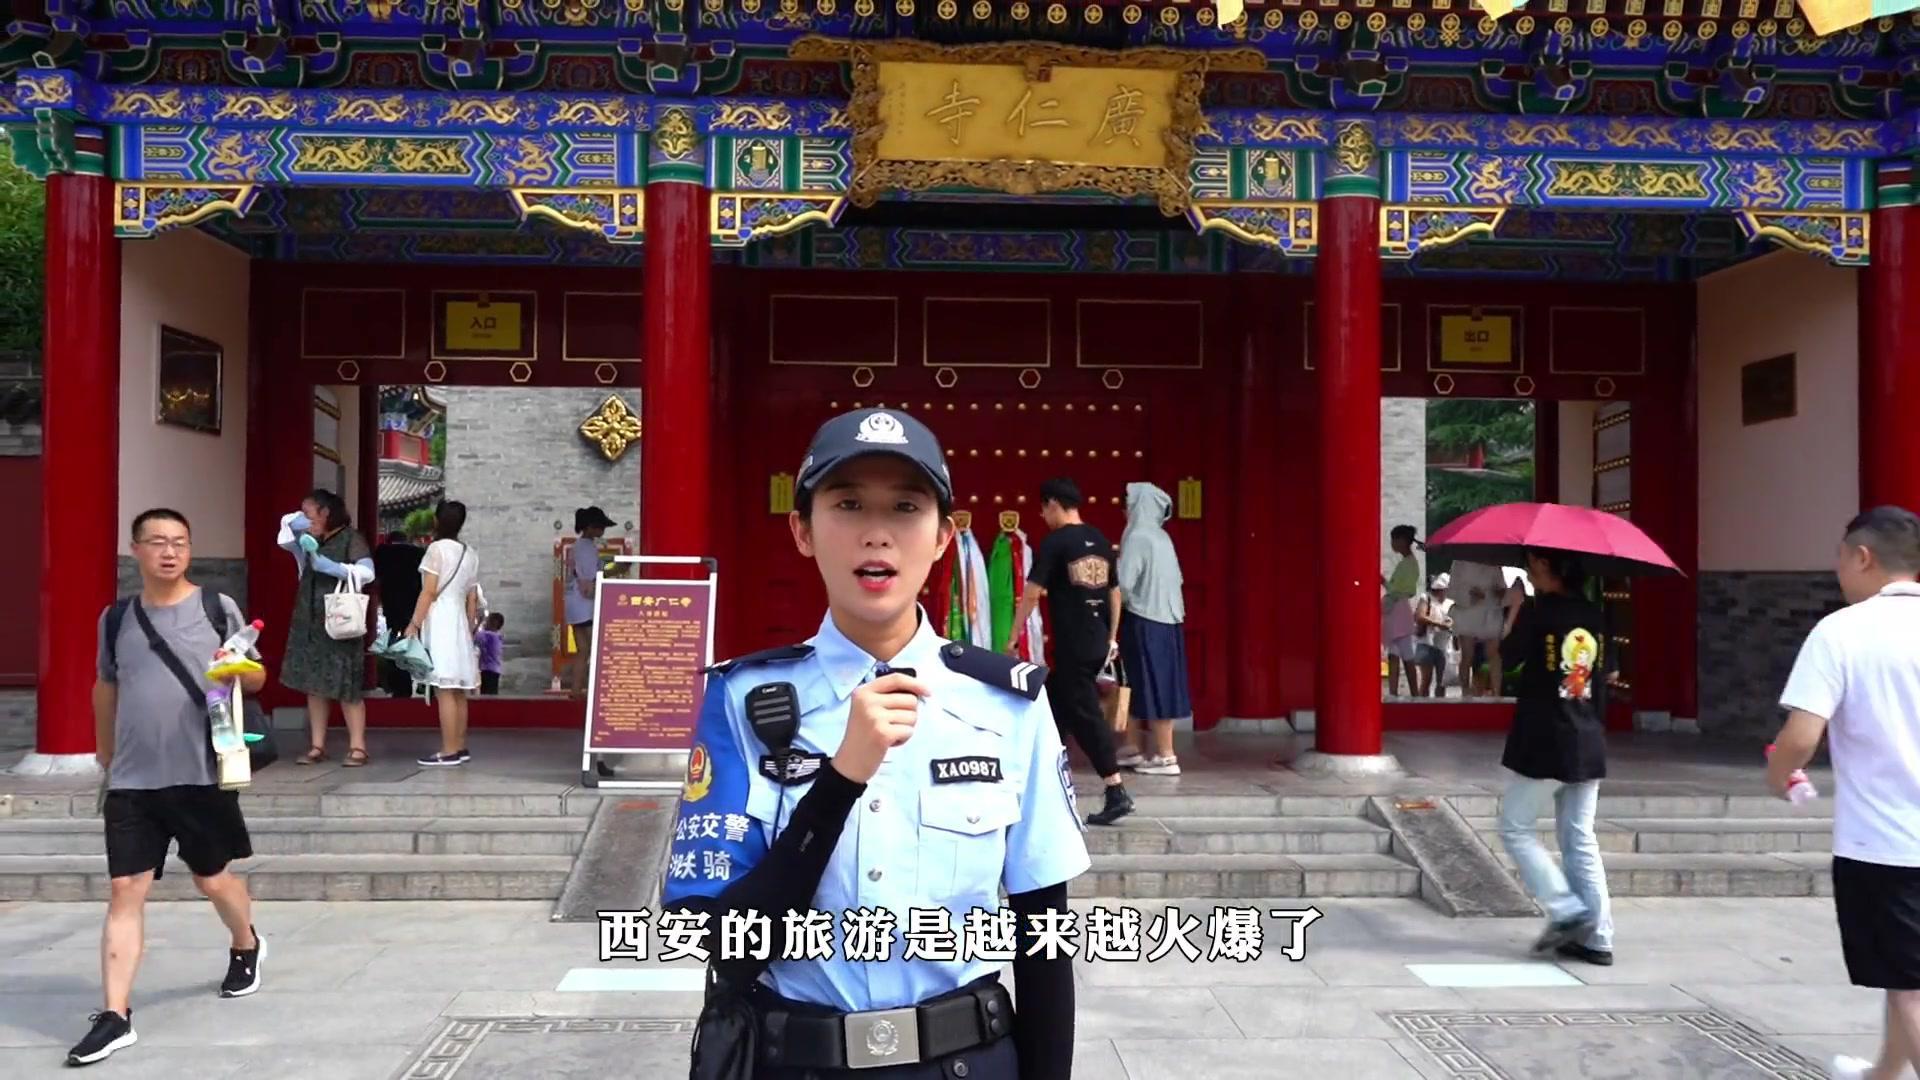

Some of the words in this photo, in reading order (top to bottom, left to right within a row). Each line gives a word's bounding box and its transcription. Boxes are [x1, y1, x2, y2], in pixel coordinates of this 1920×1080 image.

[469, 315, 497, 330] 入口
[1463, 328, 1490, 343] 出口
[937, 760, 998, 779] XA0987
[676, 812, 750, 843] 公安交警
